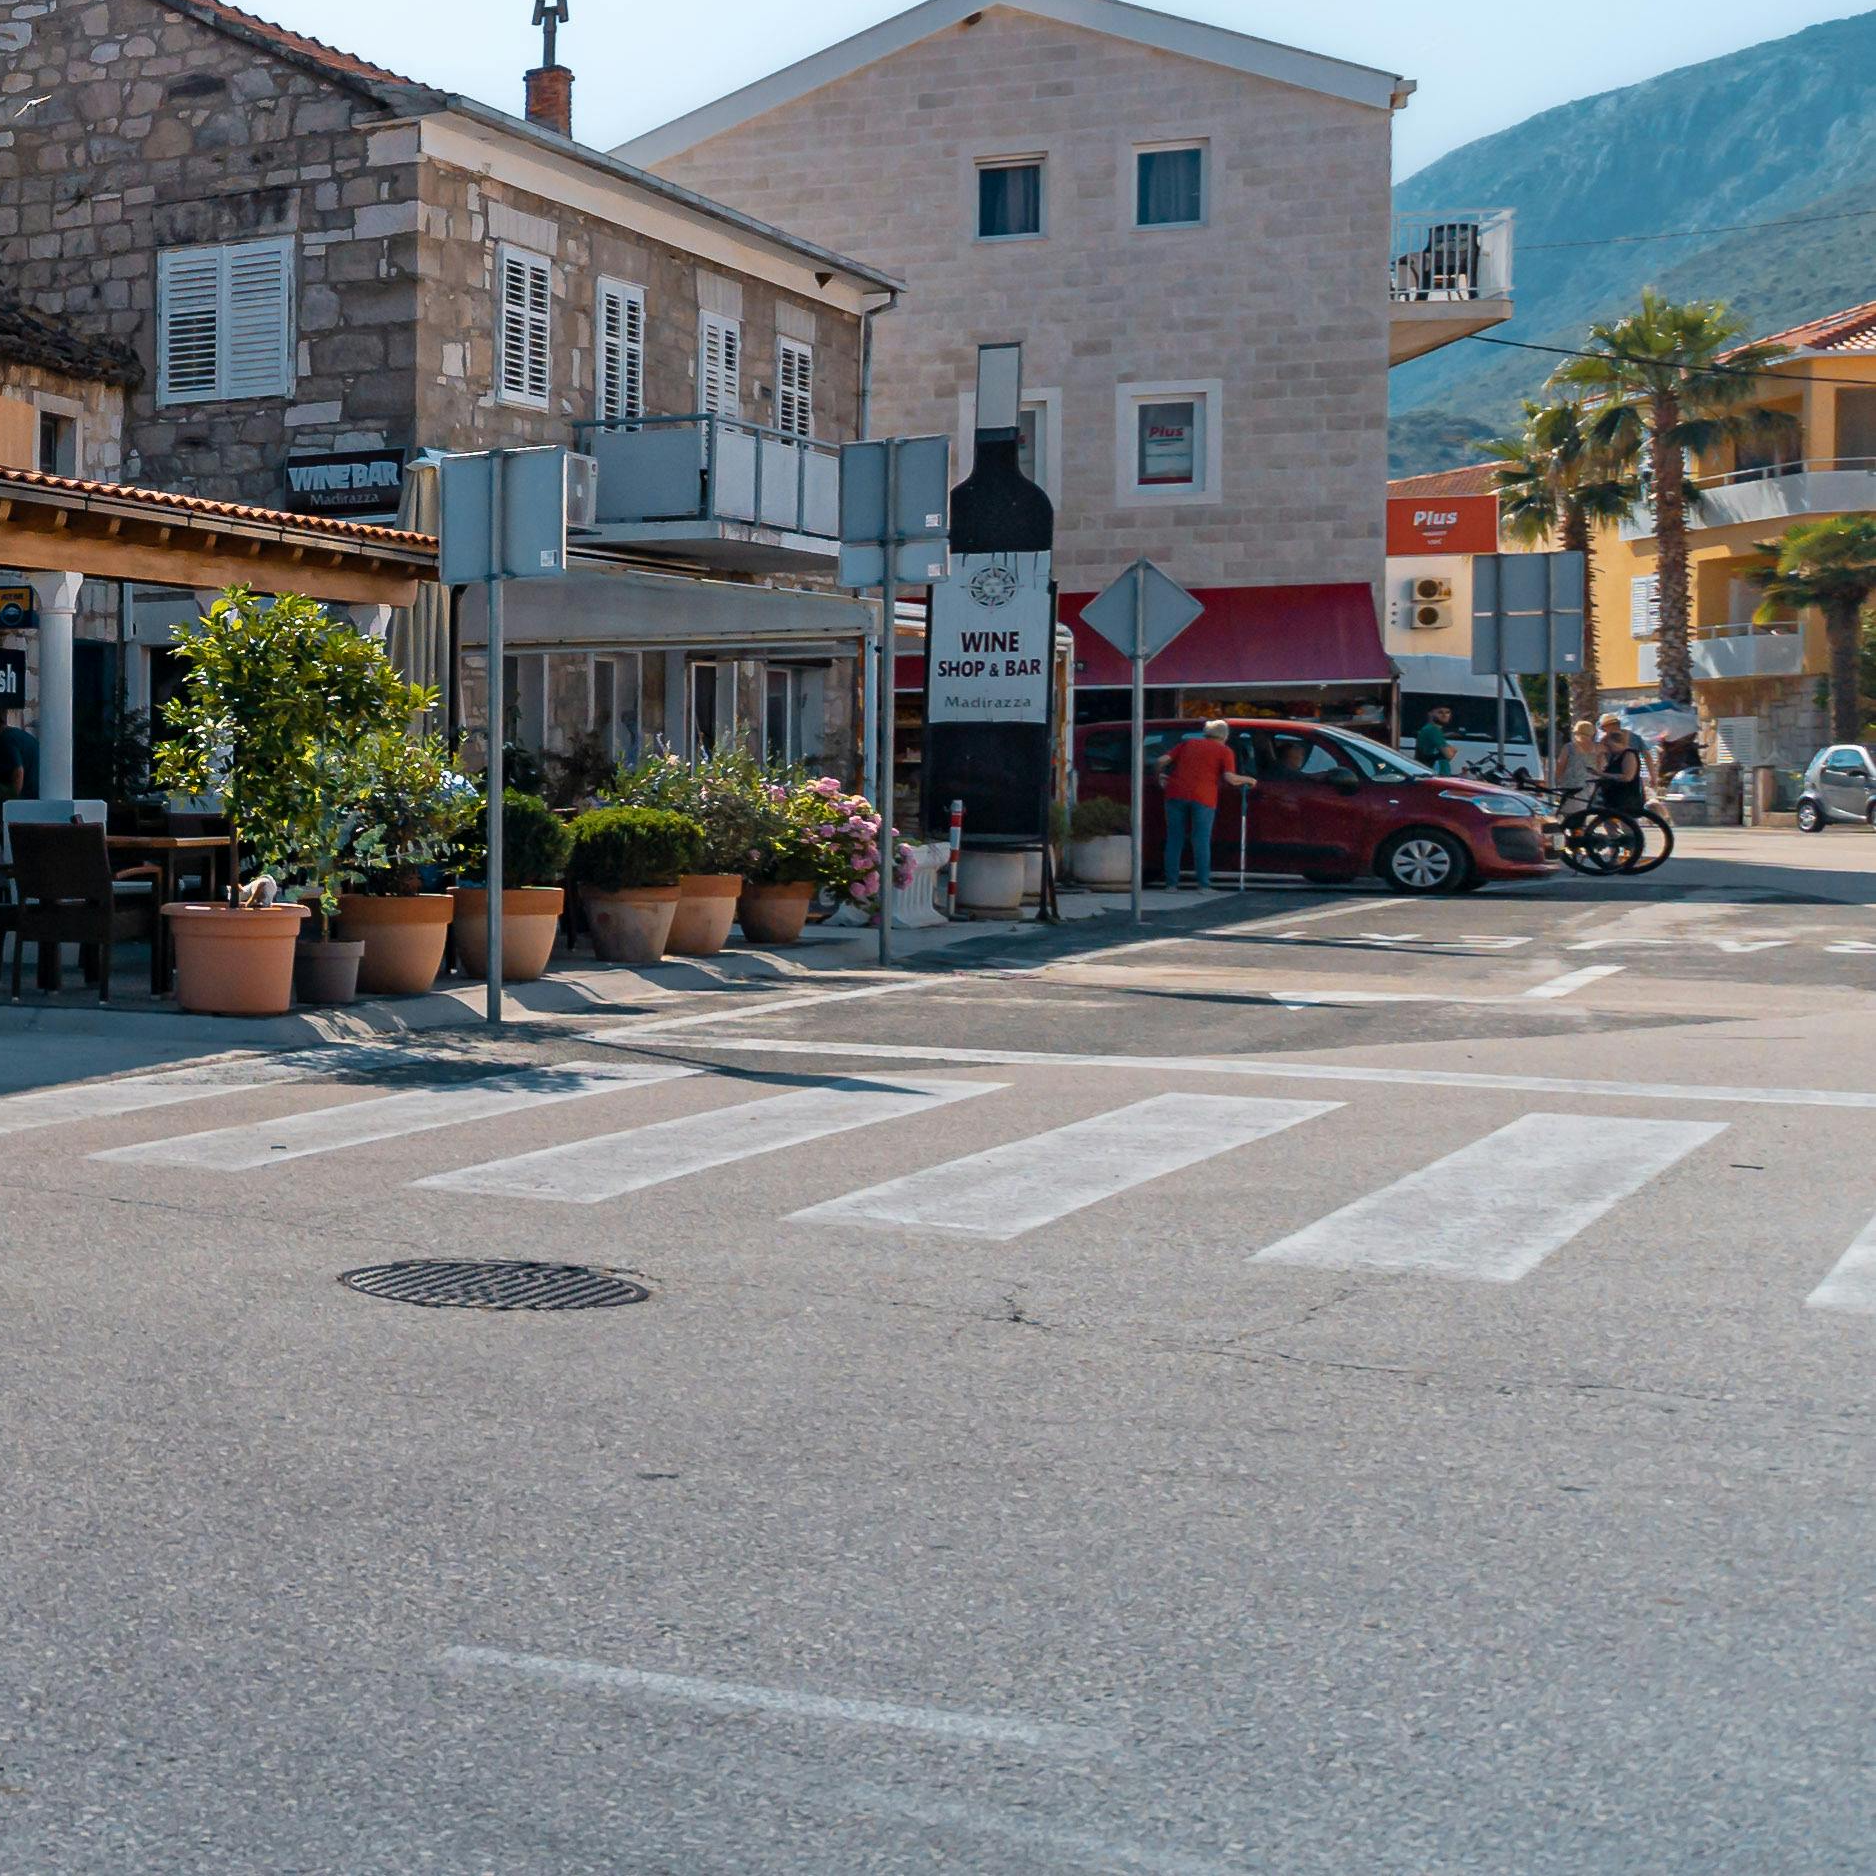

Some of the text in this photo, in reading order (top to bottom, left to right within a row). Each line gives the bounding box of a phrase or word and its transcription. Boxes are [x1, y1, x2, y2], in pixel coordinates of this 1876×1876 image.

[1149, 426, 1185, 438] Plus
[310, 493, 380, 506] Madirazza
[1413, 511, 1458, 526] Plus
[961, 631, 1020, 653] WINE
[938, 658, 1041, 678] SHOP & BAR
[944, 696, 1032, 709] Madirazza
